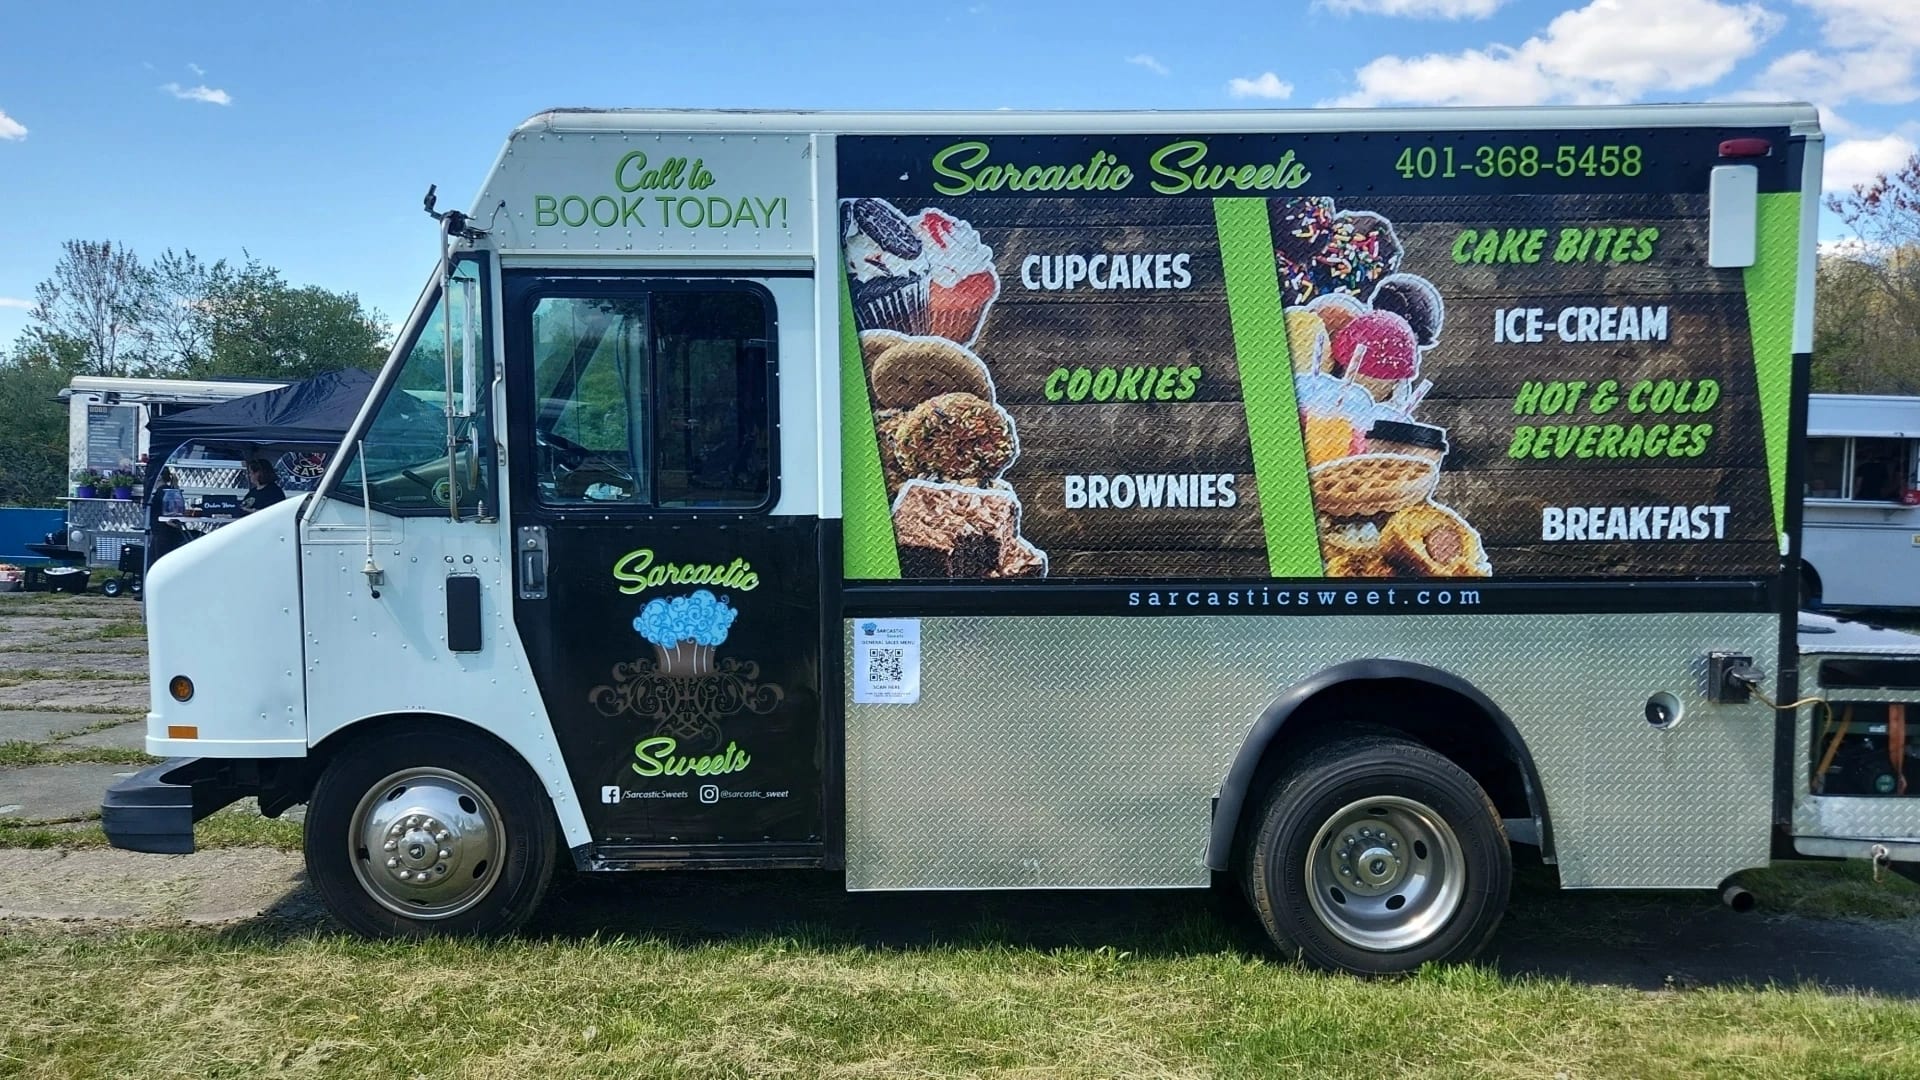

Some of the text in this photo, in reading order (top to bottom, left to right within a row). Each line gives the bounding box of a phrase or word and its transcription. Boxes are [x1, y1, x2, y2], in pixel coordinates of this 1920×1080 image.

[614, 150, 715, 192] Call to
[932, 141, 1312, 196] Sarcastic Sweets
[1395, 145, 1643, 179] 401-368-5458
[535, 195, 787, 228] BOOK TODAY!
[1451, 226, 1660, 265] CAKE BITES
[1020, 252, 1193, 291] CUPCAKES
[1494, 305, 1669, 343] ICE-CREAM
[1043, 365, 1202, 402] COOKIES
[1512, 379, 1720, 416] HOT & COLD
[1507, 423, 1713, 460] BEVERAGES
[1064, 474, 1238, 509] BROWNIES
[1542, 506, 1731, 541] BREAKFAST
[613, 549, 760, 595] Sarcastic
[1128, 586, 1482, 606] sarcasticsweet.com
[632, 736, 751, 777] Sweets
[621, 790, 689, 800] /SarcasticSweets
[720, 789, 789, 799] @sarcastic_sweet
